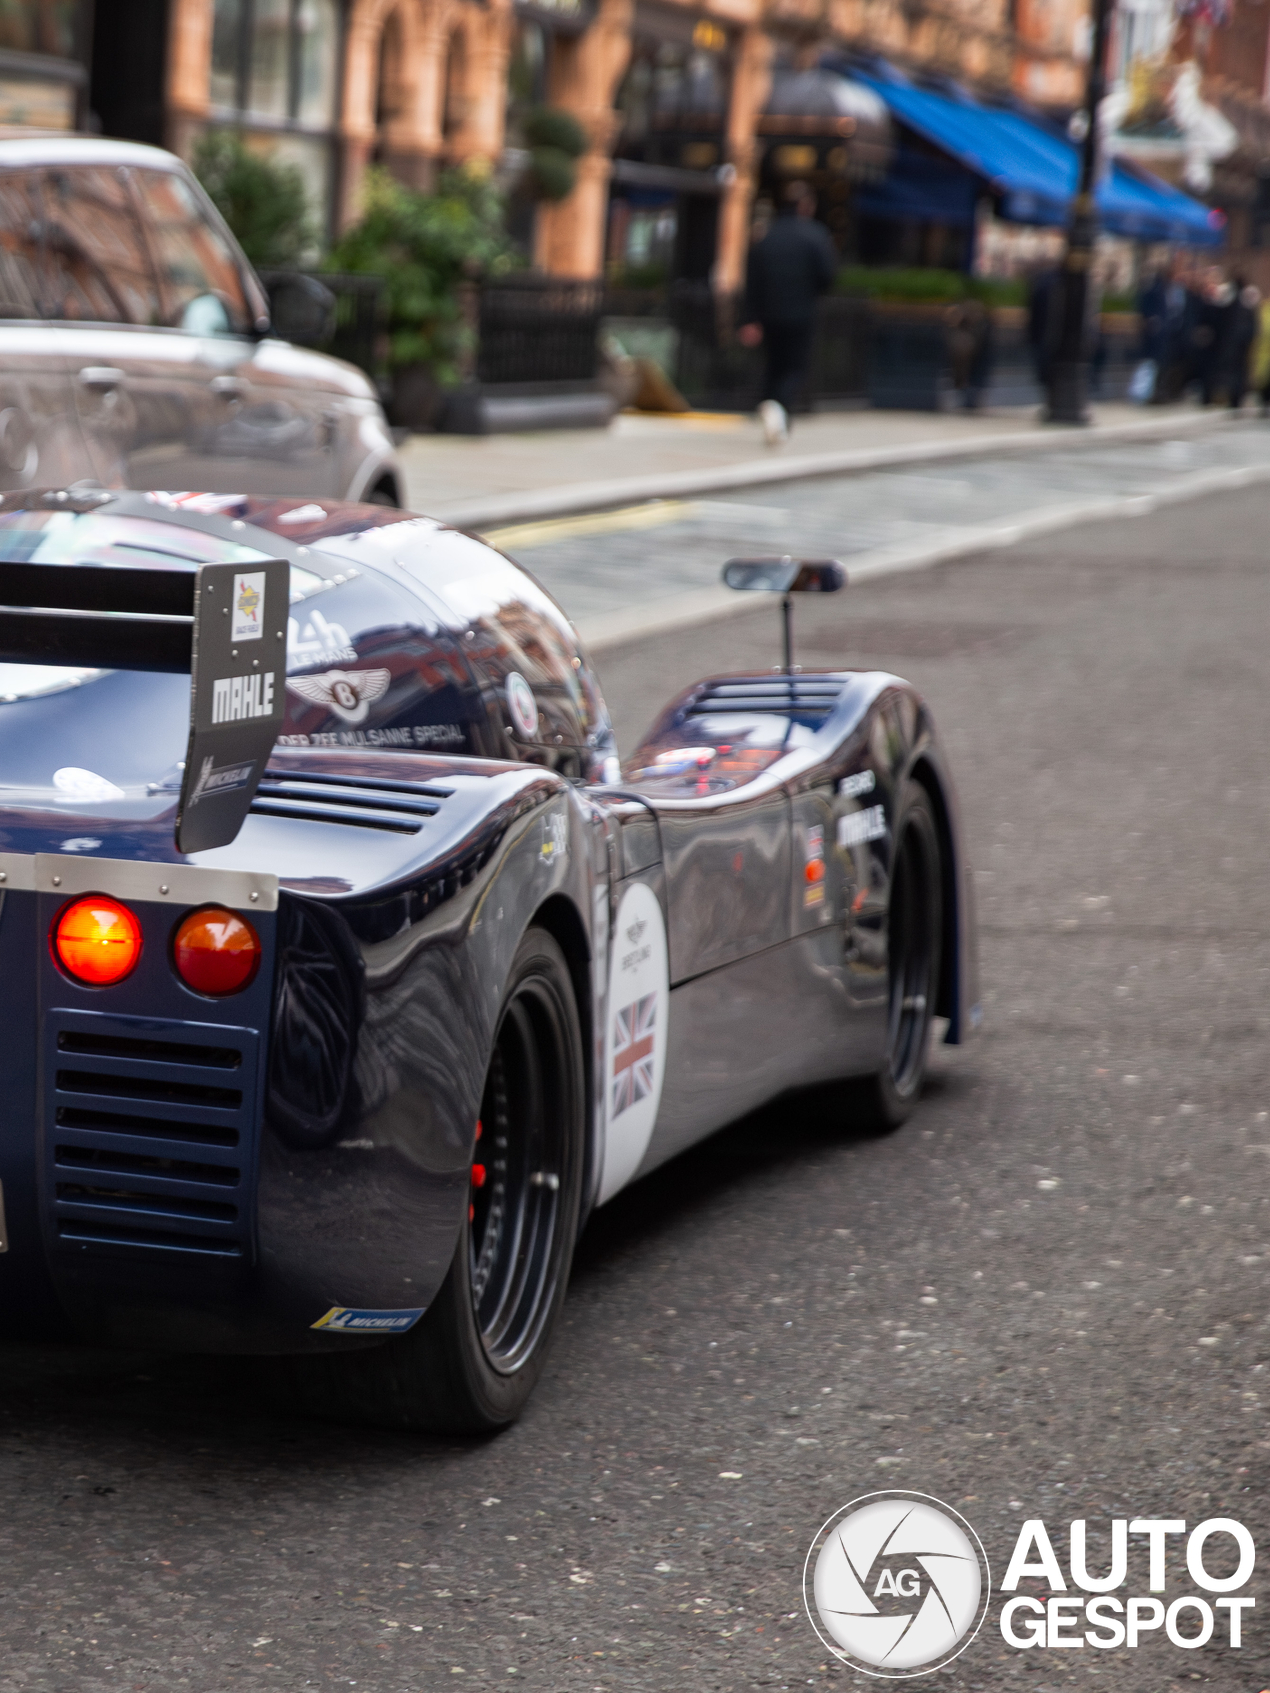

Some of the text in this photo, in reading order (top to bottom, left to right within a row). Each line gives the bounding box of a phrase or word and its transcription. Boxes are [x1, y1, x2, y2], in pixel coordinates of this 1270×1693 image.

[313, 646, 357, 663] MANS
[211, 671, 275, 724] MAHLE
[340, 726, 414, 746] MULSANNE
[413, 724, 466, 743] SPECIAL
[347, 1316, 412, 1327] MICHELIN
